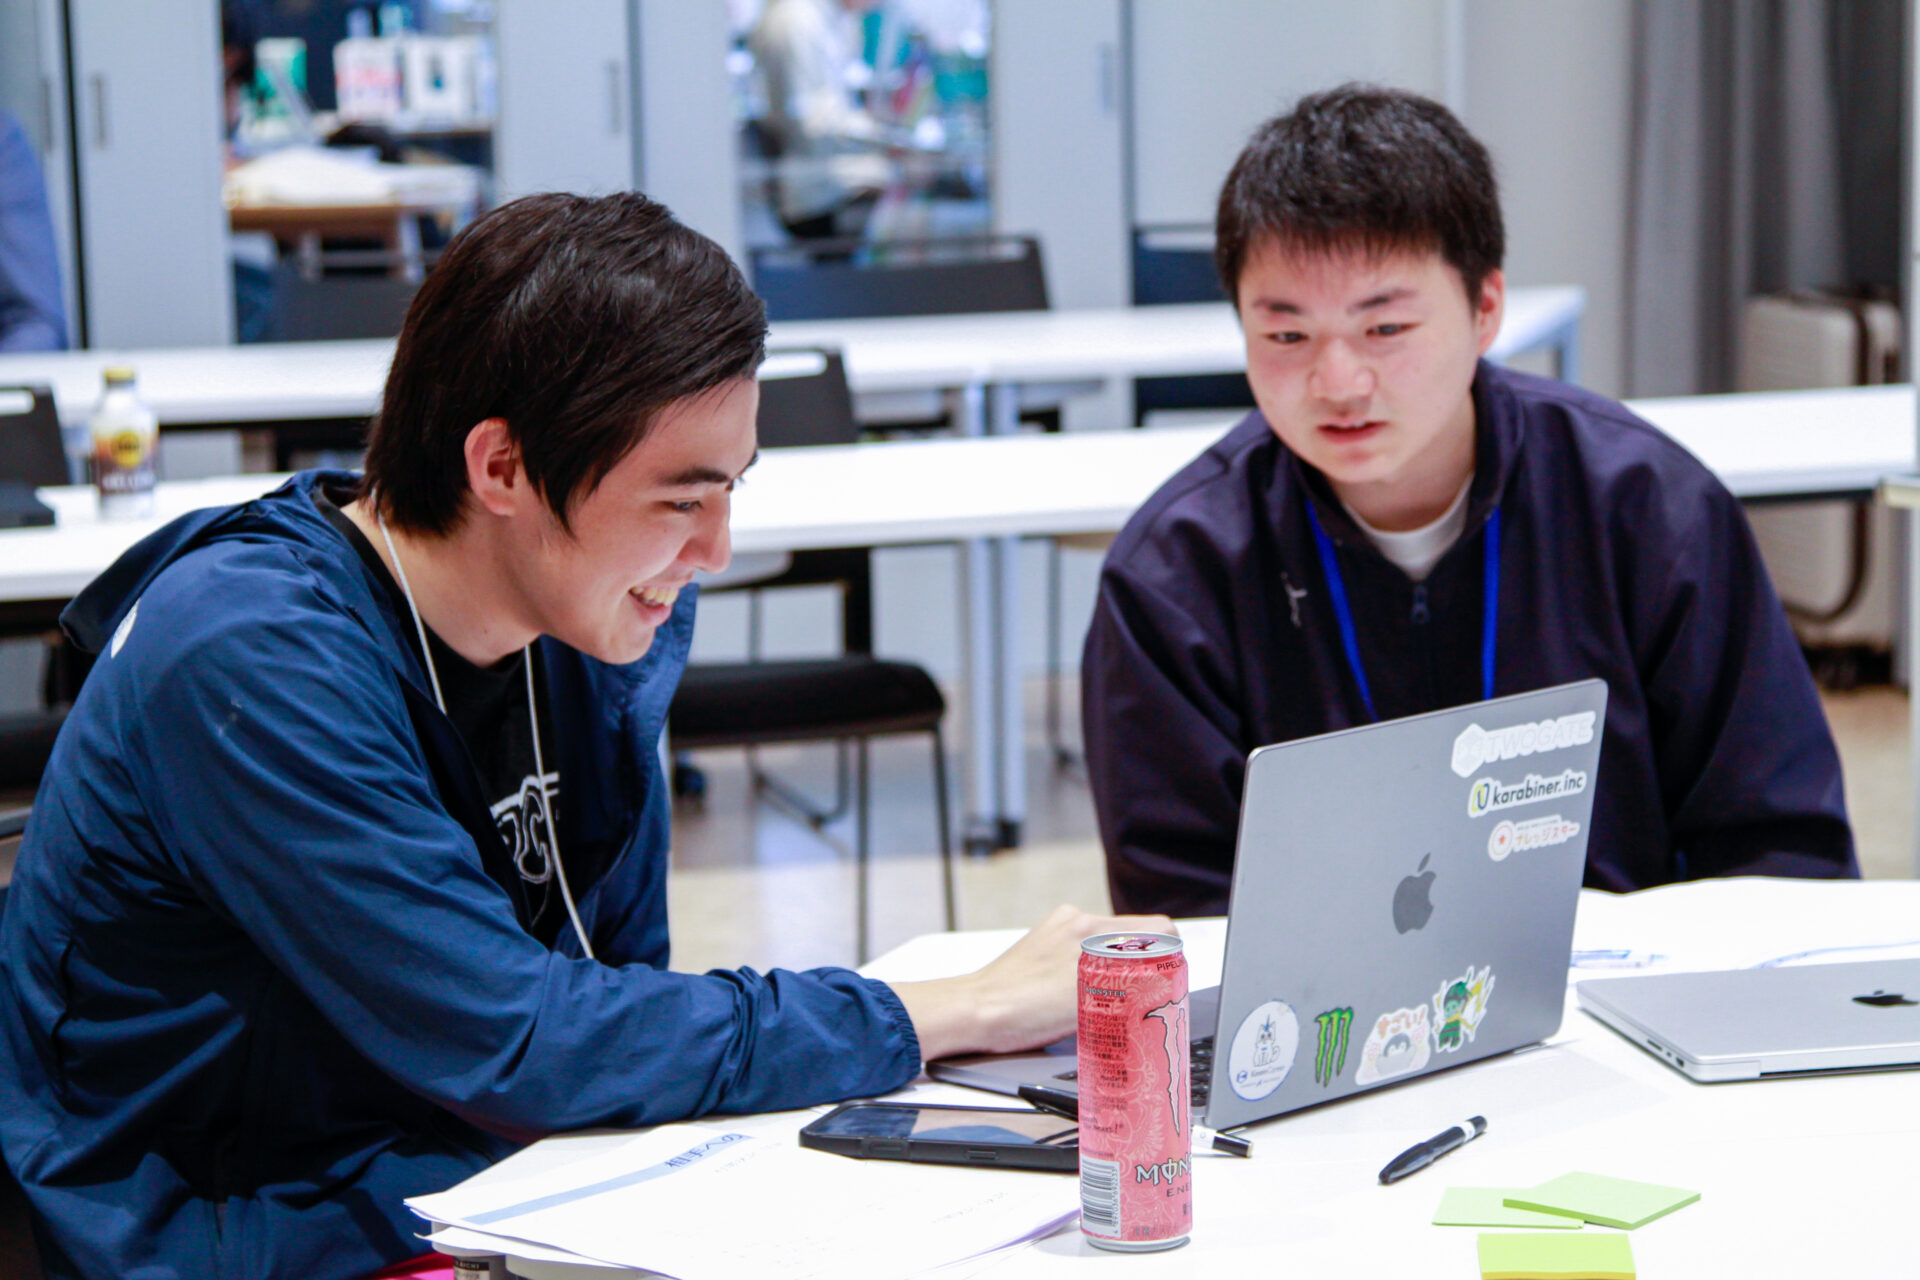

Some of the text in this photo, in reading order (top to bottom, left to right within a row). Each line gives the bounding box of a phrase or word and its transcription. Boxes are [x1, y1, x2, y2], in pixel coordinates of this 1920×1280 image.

[1486, 717, 1591, 756] TWOGATE
[1492, 773, 1584, 806] karabiner.inc
[1156, 958, 1184, 972] PIPEL
